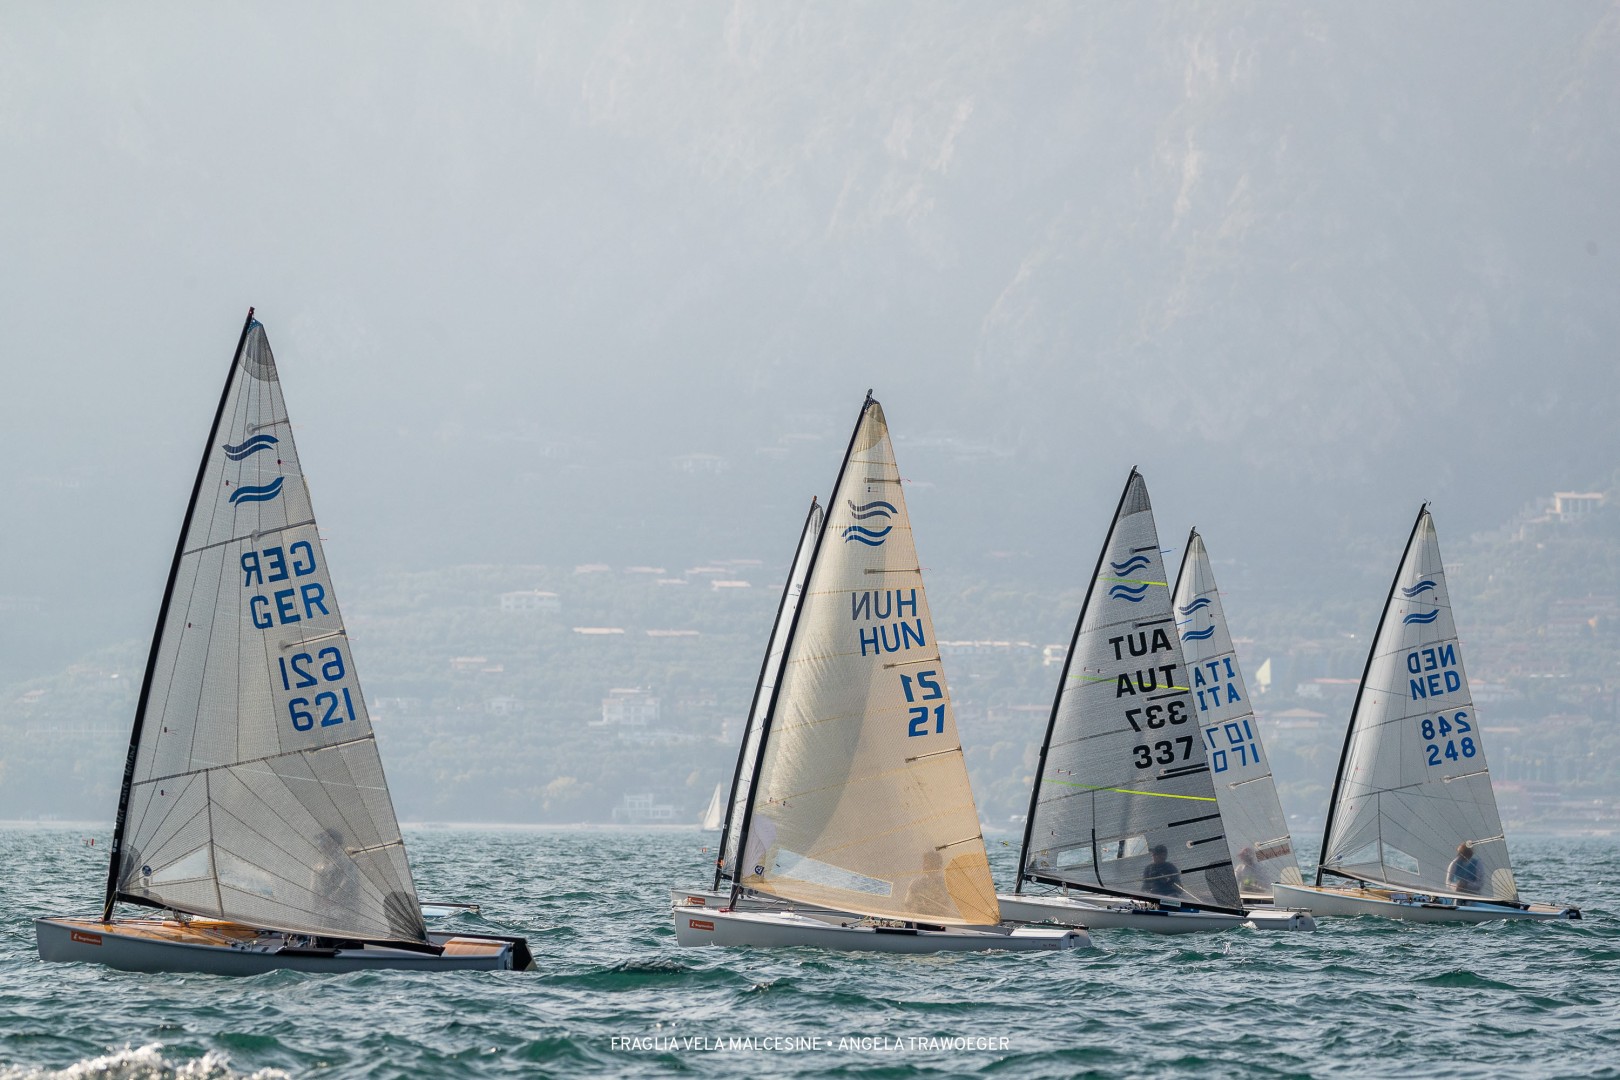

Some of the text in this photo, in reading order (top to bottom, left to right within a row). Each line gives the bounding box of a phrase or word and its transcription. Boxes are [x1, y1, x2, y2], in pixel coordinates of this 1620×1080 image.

[250, 582, 330, 630] GER
[859, 618, 926, 656] HUN
[1116, 663, 1177, 698] AUT
[1197, 682, 1241, 711] ITA
[1409, 670, 1461, 701] NED
[288, 687, 356, 732] 621
[908, 703, 945, 737] 21
[1132, 735, 1194, 769] 337
[1212, 742, 1260, 773] 071
[1426, 736, 1476, 766] 248
